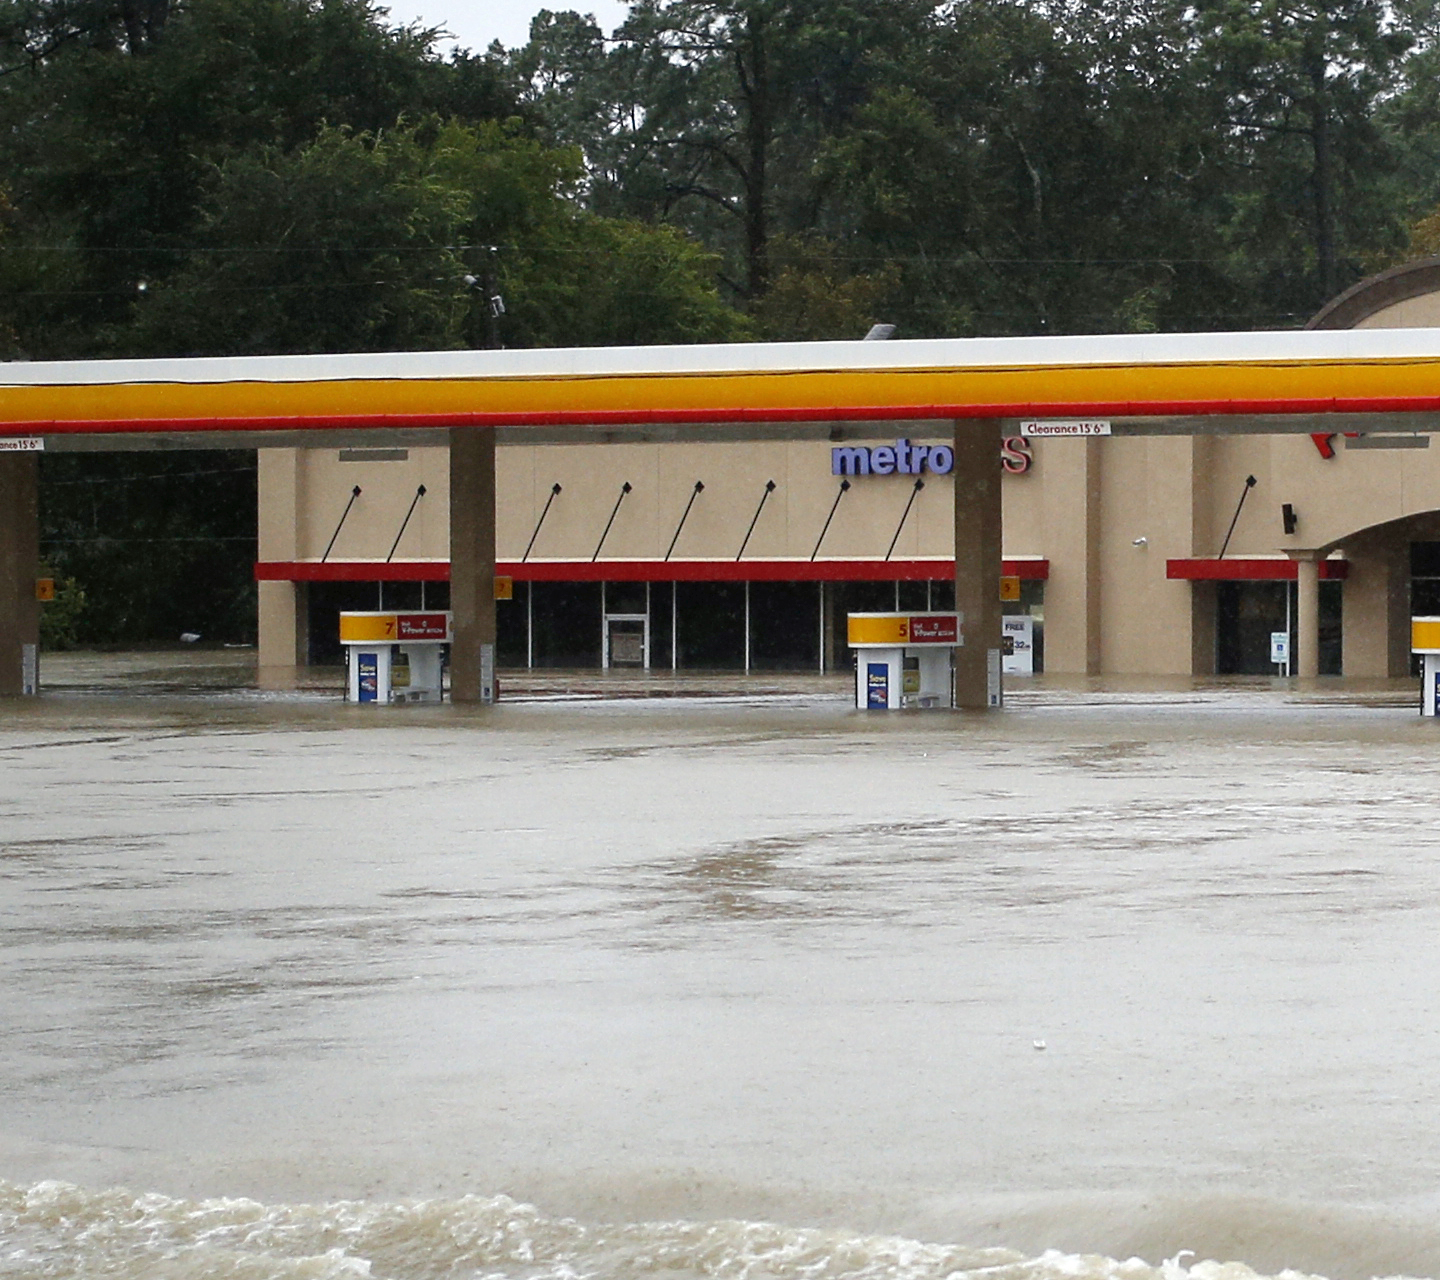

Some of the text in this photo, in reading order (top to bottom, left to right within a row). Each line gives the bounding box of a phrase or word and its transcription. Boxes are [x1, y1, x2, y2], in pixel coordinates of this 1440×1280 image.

[1027, 424, 1078, 433] Clearance
[385, 623, 395, 635] 7
[899, 624, 907, 637] 5
[1005, 623, 1024, 631] FREE
